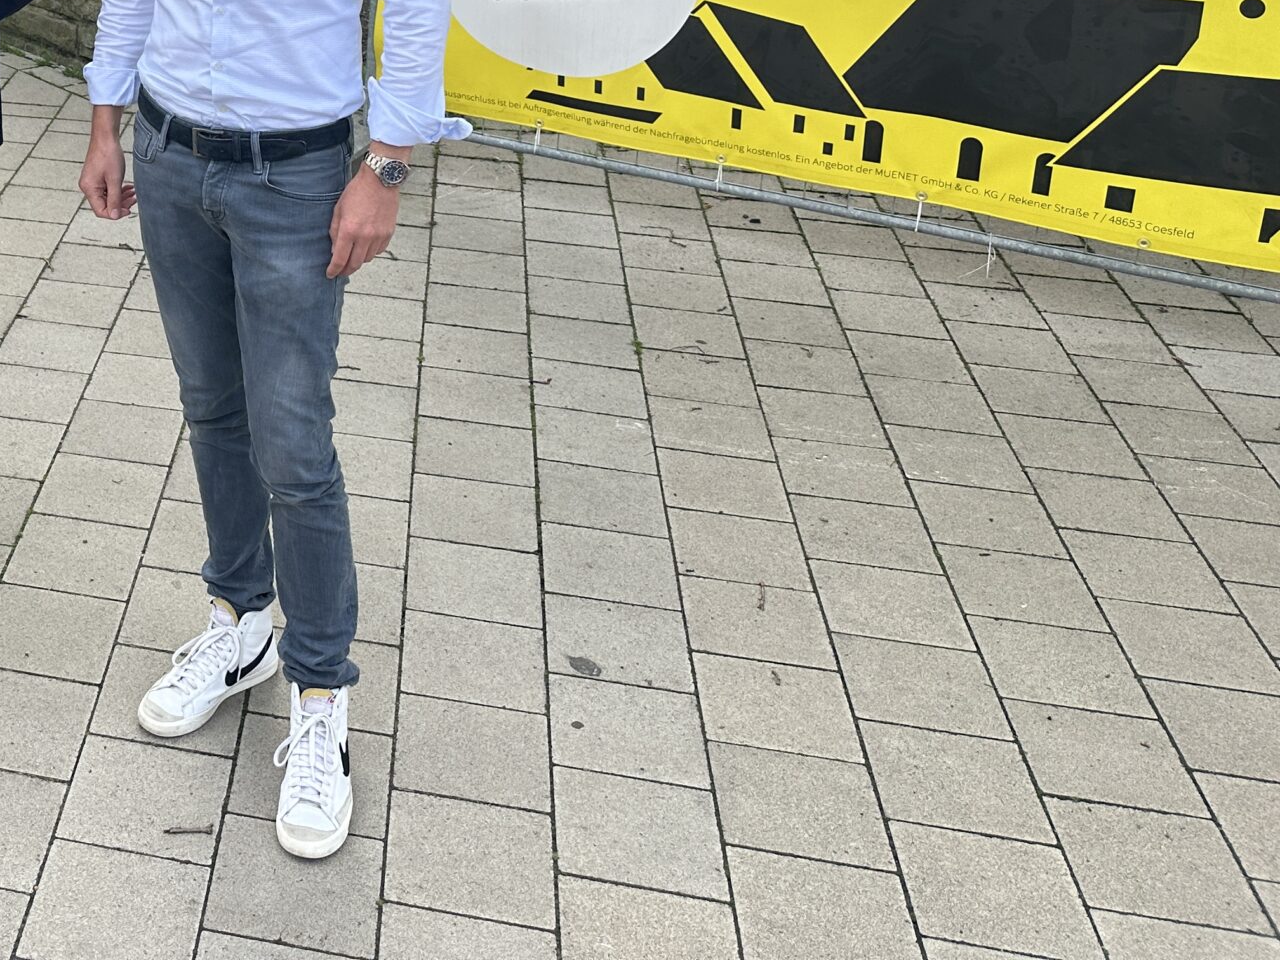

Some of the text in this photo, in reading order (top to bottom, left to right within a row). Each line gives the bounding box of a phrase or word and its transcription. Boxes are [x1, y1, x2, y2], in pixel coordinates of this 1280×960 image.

[497, 99, 507, 107] ist
[508, 101, 522, 109] bei
[523, 103, 592, 125] Auftragserteilung
[593, 118, 631, 132] während
[632, 124, 648, 135] der
[746, 144, 793, 161] kostenlos.
[795, 154, 811, 165] Ein
[812, 157, 854, 172] Angebot
[855, 165, 873, 175] der
[874, 168, 919, 182] MUENET
[920, 175, 952, 190] GmbH
[954, 182, 963, 191] &
[964, 184, 981, 196] Co.
[983, 189, 999, 199] KG
[1008, 193, 1052, 210] Rekener
[1054, 203, 1090, 219] Straße
[1092, 211, 1099, 220] 7
[1108, 215, 1143, 230] 48653
[1144, 222, 1195, 240] Coesfeld
